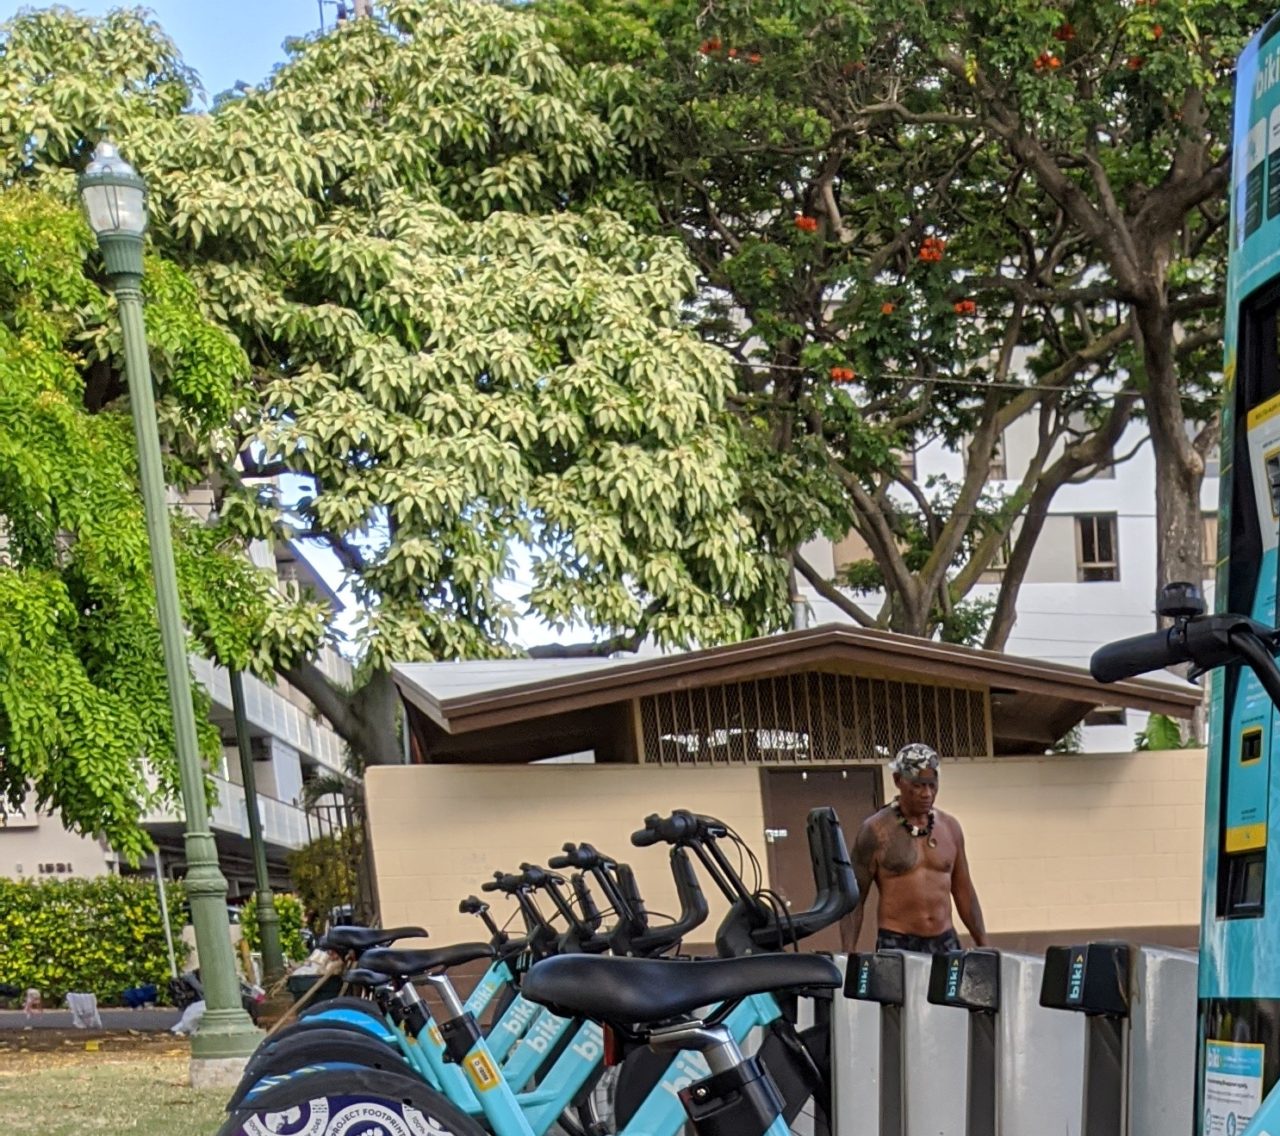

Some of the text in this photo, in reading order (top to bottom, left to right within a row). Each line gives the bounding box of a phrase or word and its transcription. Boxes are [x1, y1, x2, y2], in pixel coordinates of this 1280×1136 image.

[860, 966, 869, 994] biki
[947, 966, 959, 997] biki
[1069, 963, 1083, 999] biki
[362, 1108, 406, 1136] FOOTPRINT
